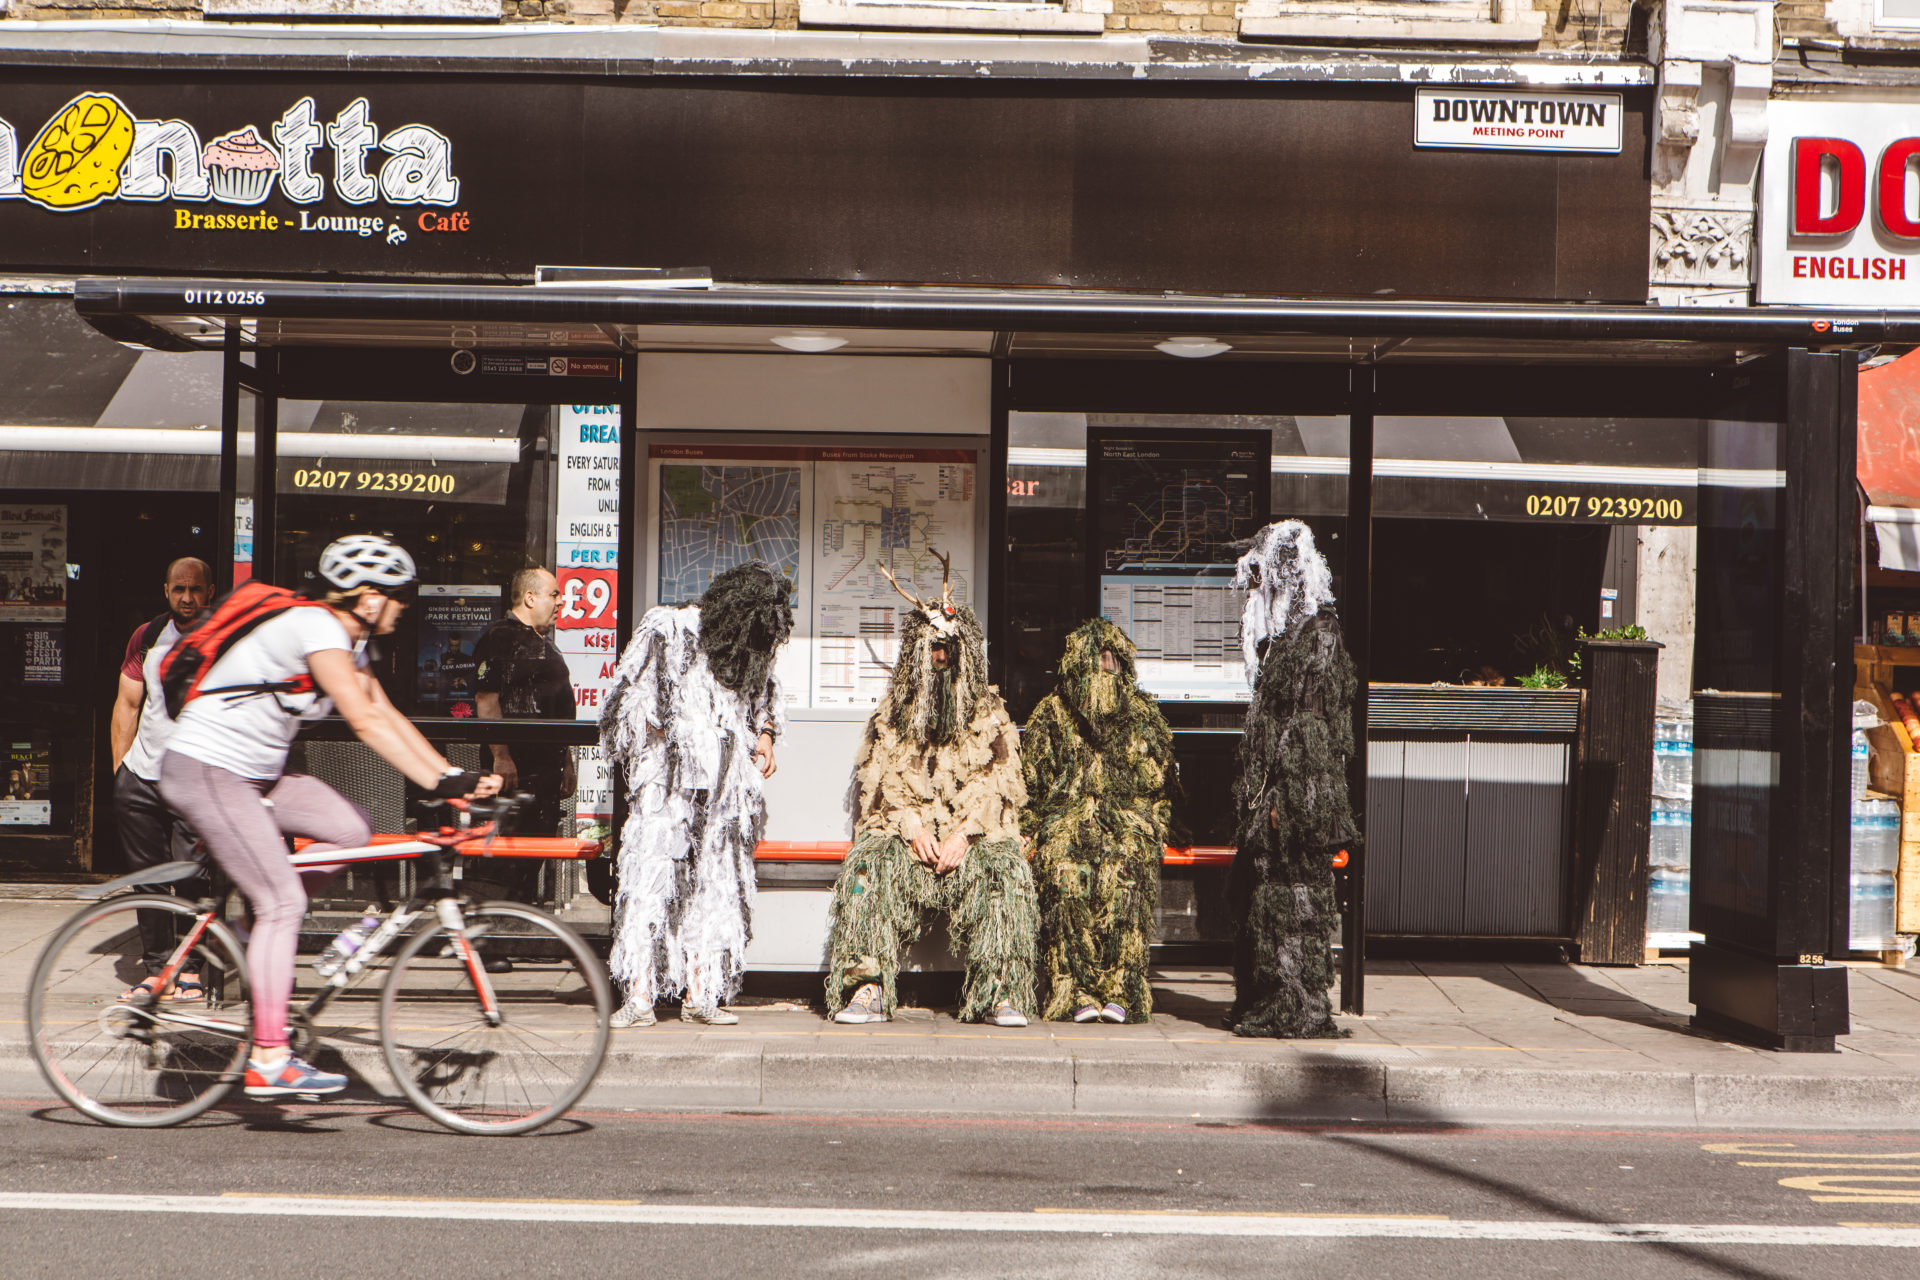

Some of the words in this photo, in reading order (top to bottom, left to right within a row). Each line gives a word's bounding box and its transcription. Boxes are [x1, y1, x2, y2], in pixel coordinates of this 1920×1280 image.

[1432, 98, 1607, 127] DOWNTOWN
[1472, 126, 1525, 138] MEETING
[1528, 128, 1566, 139] POINT
[174, 209, 279, 231] Brasserie
[299, 210, 384, 237] Lounge
[417, 210, 471, 233] Café
[1793, 256, 1906, 281] ENGLISH
[184, 290, 223, 305] 0112
[226, 290, 266, 306] 0256
[1832, 318, 1860, 327] London
[1832, 325, 1854, 334] Buses
[570, 362, 581, 370] No
[582, 362, 609, 372] smoking
[580, 424, 621, 444] BREA
[660, 448, 684, 456] London
[685, 448, 704, 456] Buses
[822, 451, 841, 459] Buses
[879, 451, 914, 460] Newington
[1136, 451, 1160, 459] London
[567, 455, 591, 470] EVERY
[294, 469, 351, 489] 0207
[356, 472, 455, 494] 9239200
[587, 477, 611, 492] FROM
[1007, 476, 1041, 496] ar
[598, 499, 619, 513] UNLI
[1526, 494, 1581, 517] 0207
[1587, 496, 1683, 520] 9239200
[570, 523, 604, 537] ENGLISH
[571, 549, 601, 564] PER
[606, 549, 618, 563] P
[428, 613, 450, 621] PARK
[33, 631, 49, 640] BIG
[33, 640, 57, 649] SEXY
[33, 656, 62, 665] PARTY
